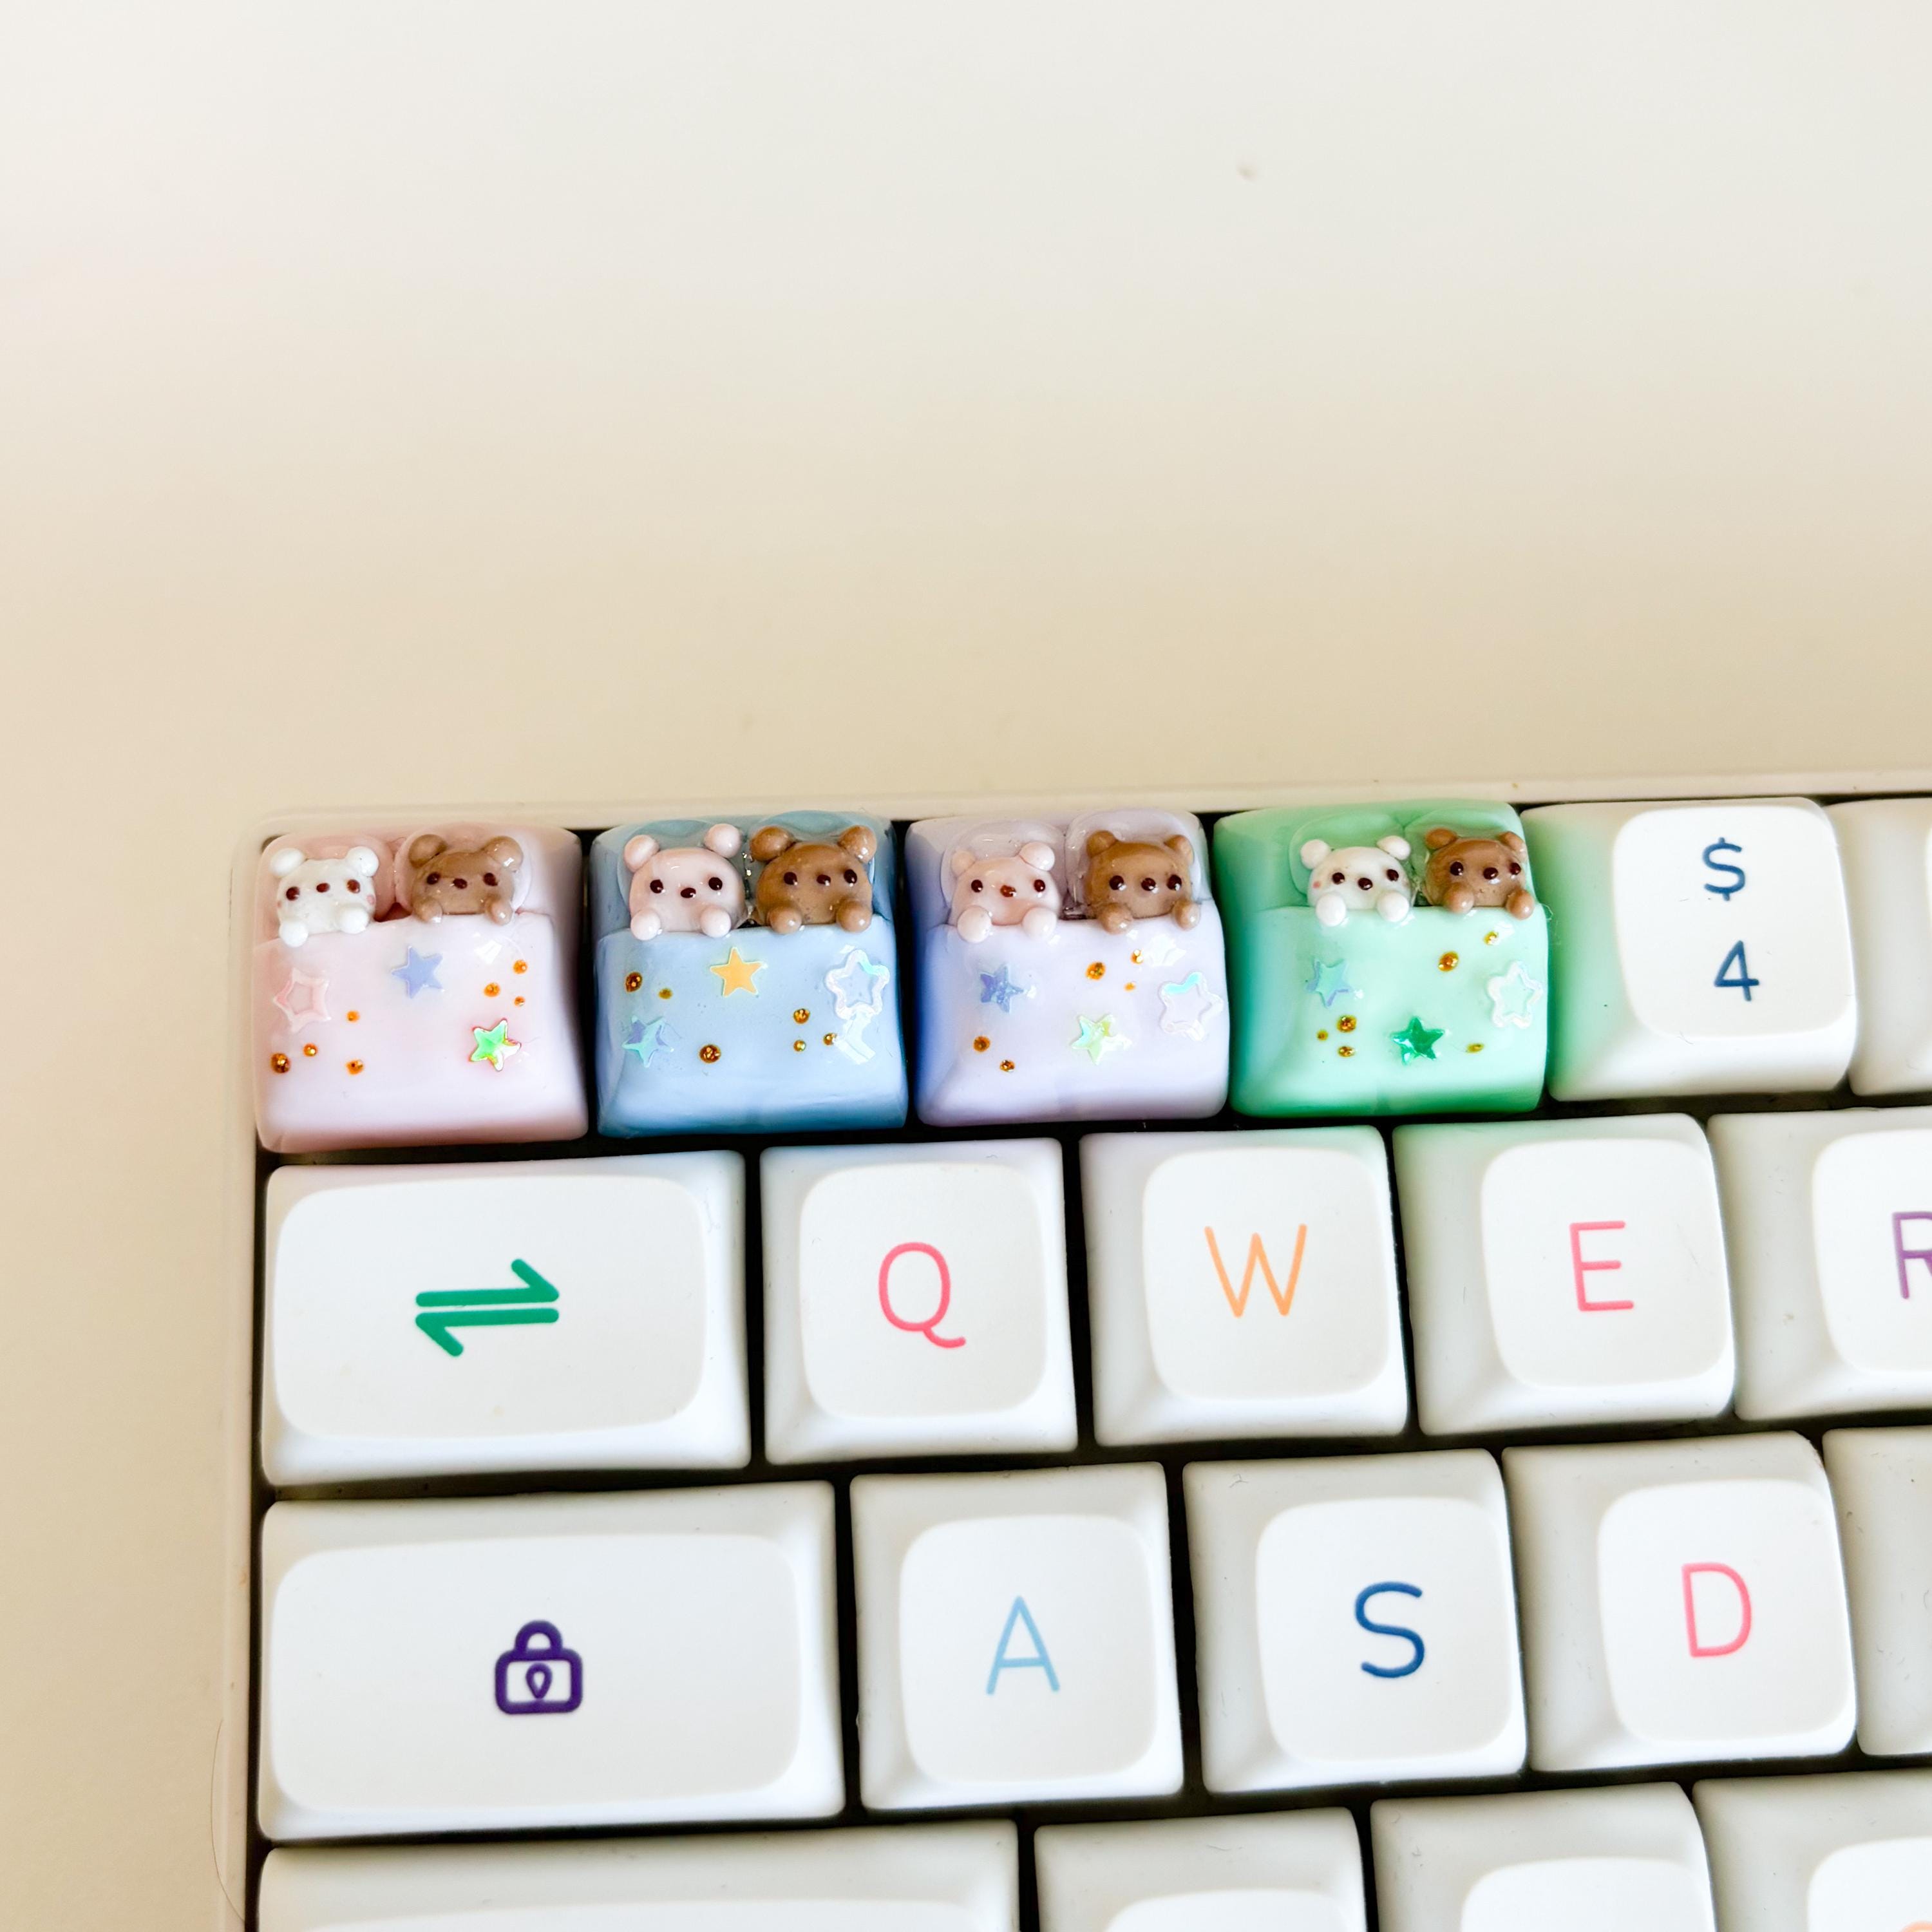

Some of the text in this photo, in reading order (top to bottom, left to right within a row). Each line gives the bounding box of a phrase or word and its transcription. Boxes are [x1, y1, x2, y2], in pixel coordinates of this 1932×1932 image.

[1703, 837, 1747, 902] $
[1714, 940, 1760, 1002] 4
[878, 1242, 966, 1349] Q
[1204, 1224, 1307, 1318] W
[1569, 1220, 1634, 1312] E
[986, 1596, 1059, 1695] A
[1354, 1580, 1426, 1680] S
[1681, 1562, 1753, 1659] D
